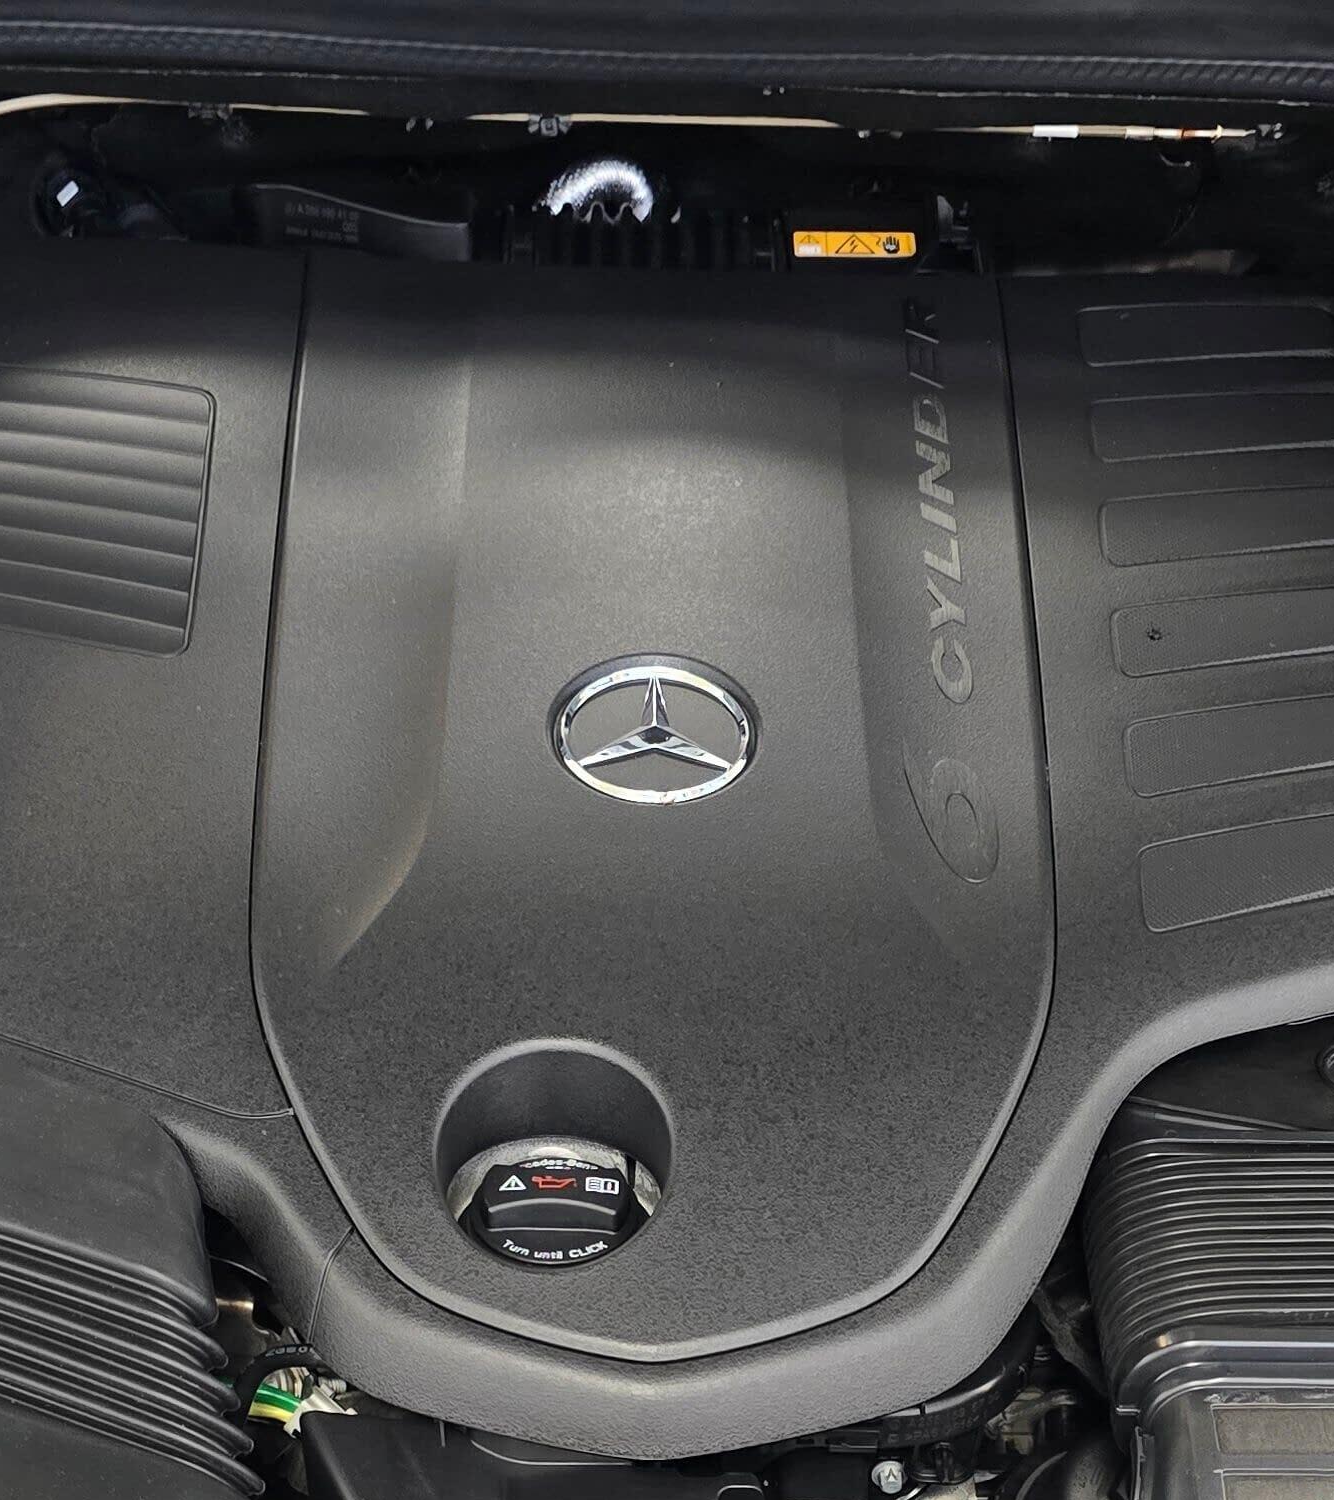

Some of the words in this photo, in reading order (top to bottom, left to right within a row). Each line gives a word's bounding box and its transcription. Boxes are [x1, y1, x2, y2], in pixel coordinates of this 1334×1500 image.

[904, 297, 974, 704] CYLINDER
[501, 1239, 529, 1256] Turn
[534, 1250, 563, 1260] until
[568, 1241, 608, 1259] CLICK
